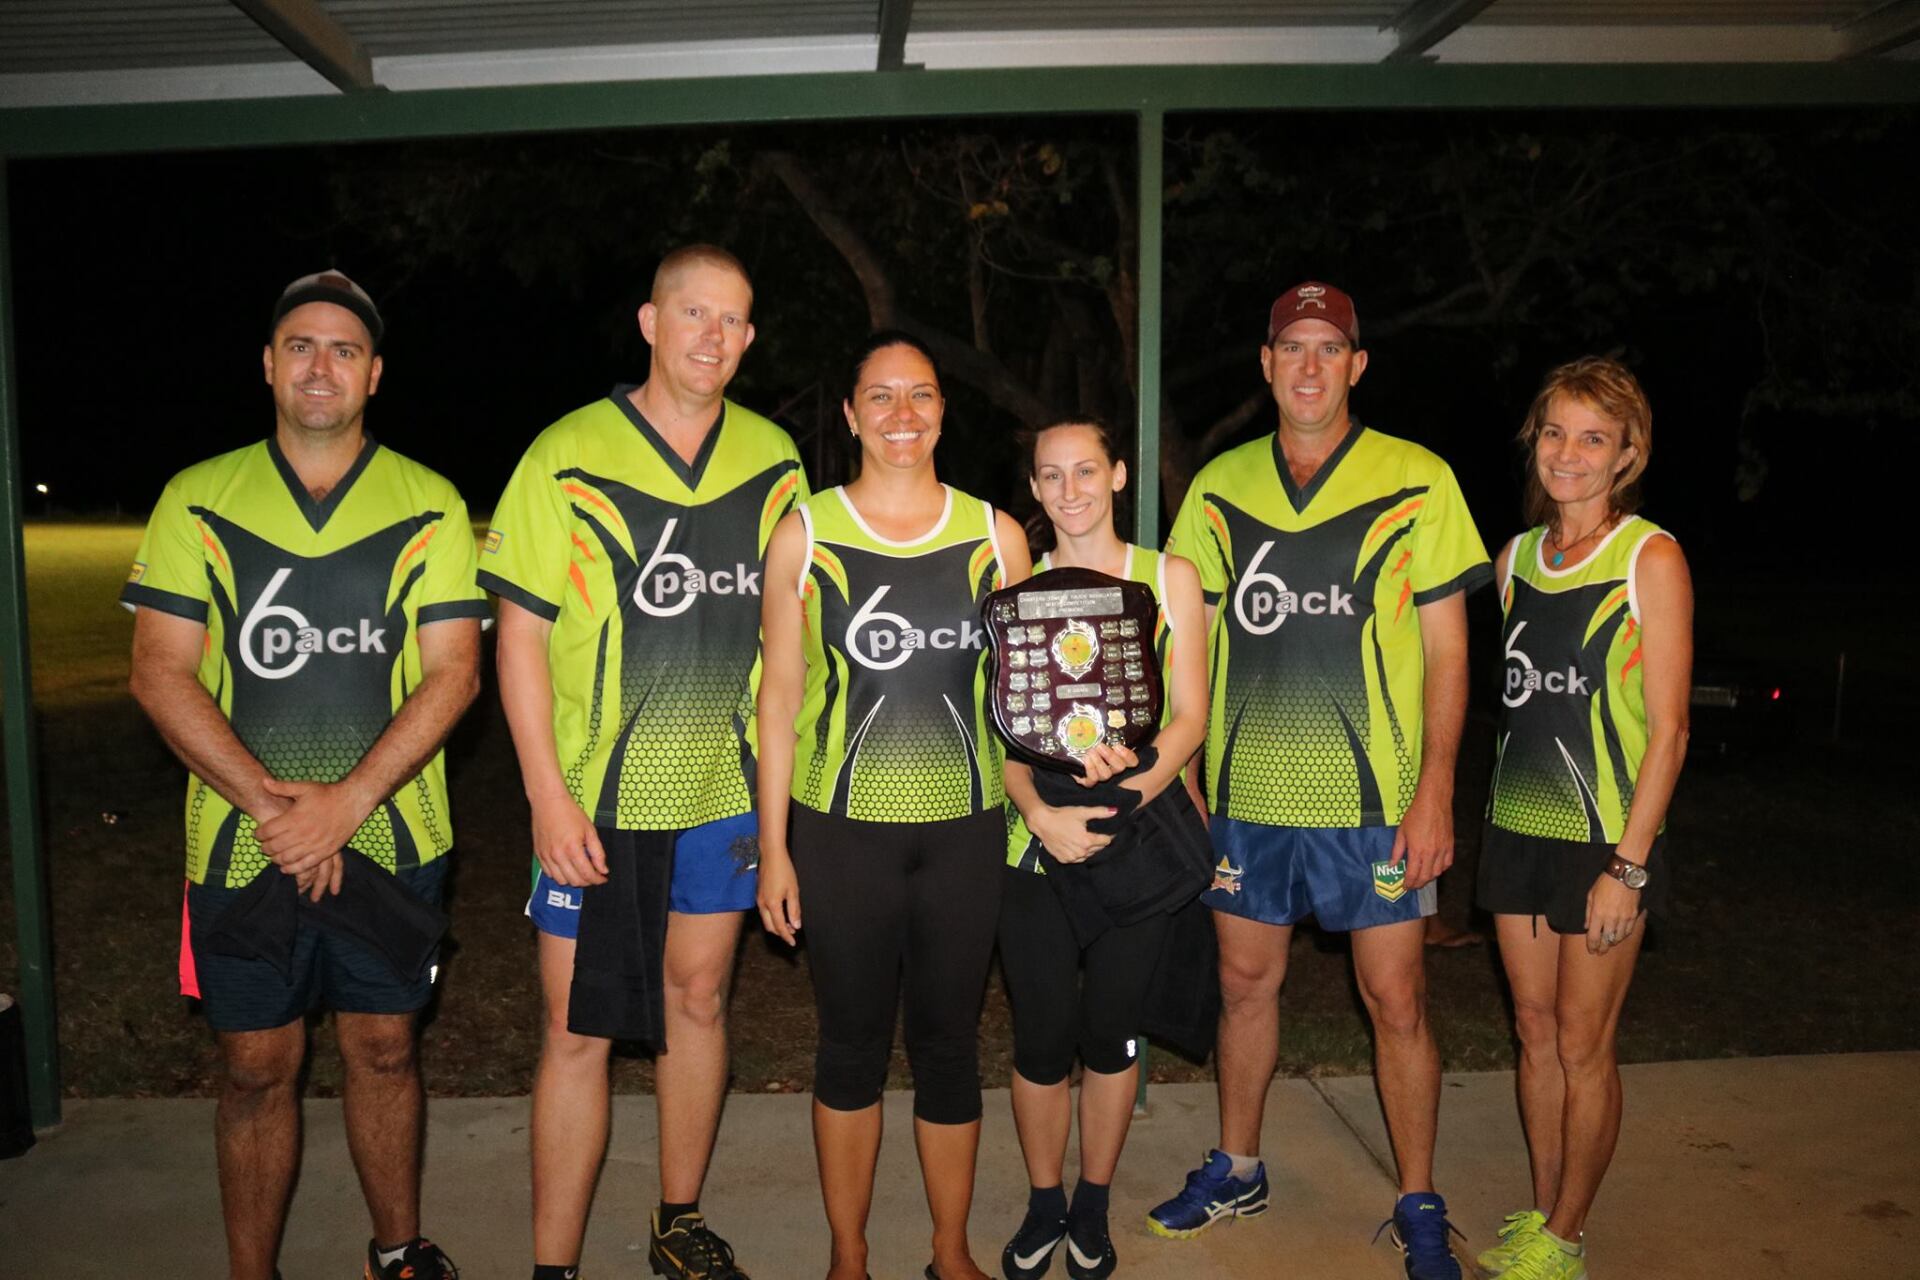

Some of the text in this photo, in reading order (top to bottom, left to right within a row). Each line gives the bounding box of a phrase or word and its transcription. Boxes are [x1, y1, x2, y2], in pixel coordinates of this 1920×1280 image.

[633, 518, 760, 617] 6 pack
[1234, 541, 1355, 635] 6 pack
[239, 568, 387, 679] 6 pack
[845, 585, 984, 670] 6 pack
[1502, 621, 1589, 708] 6 pack
